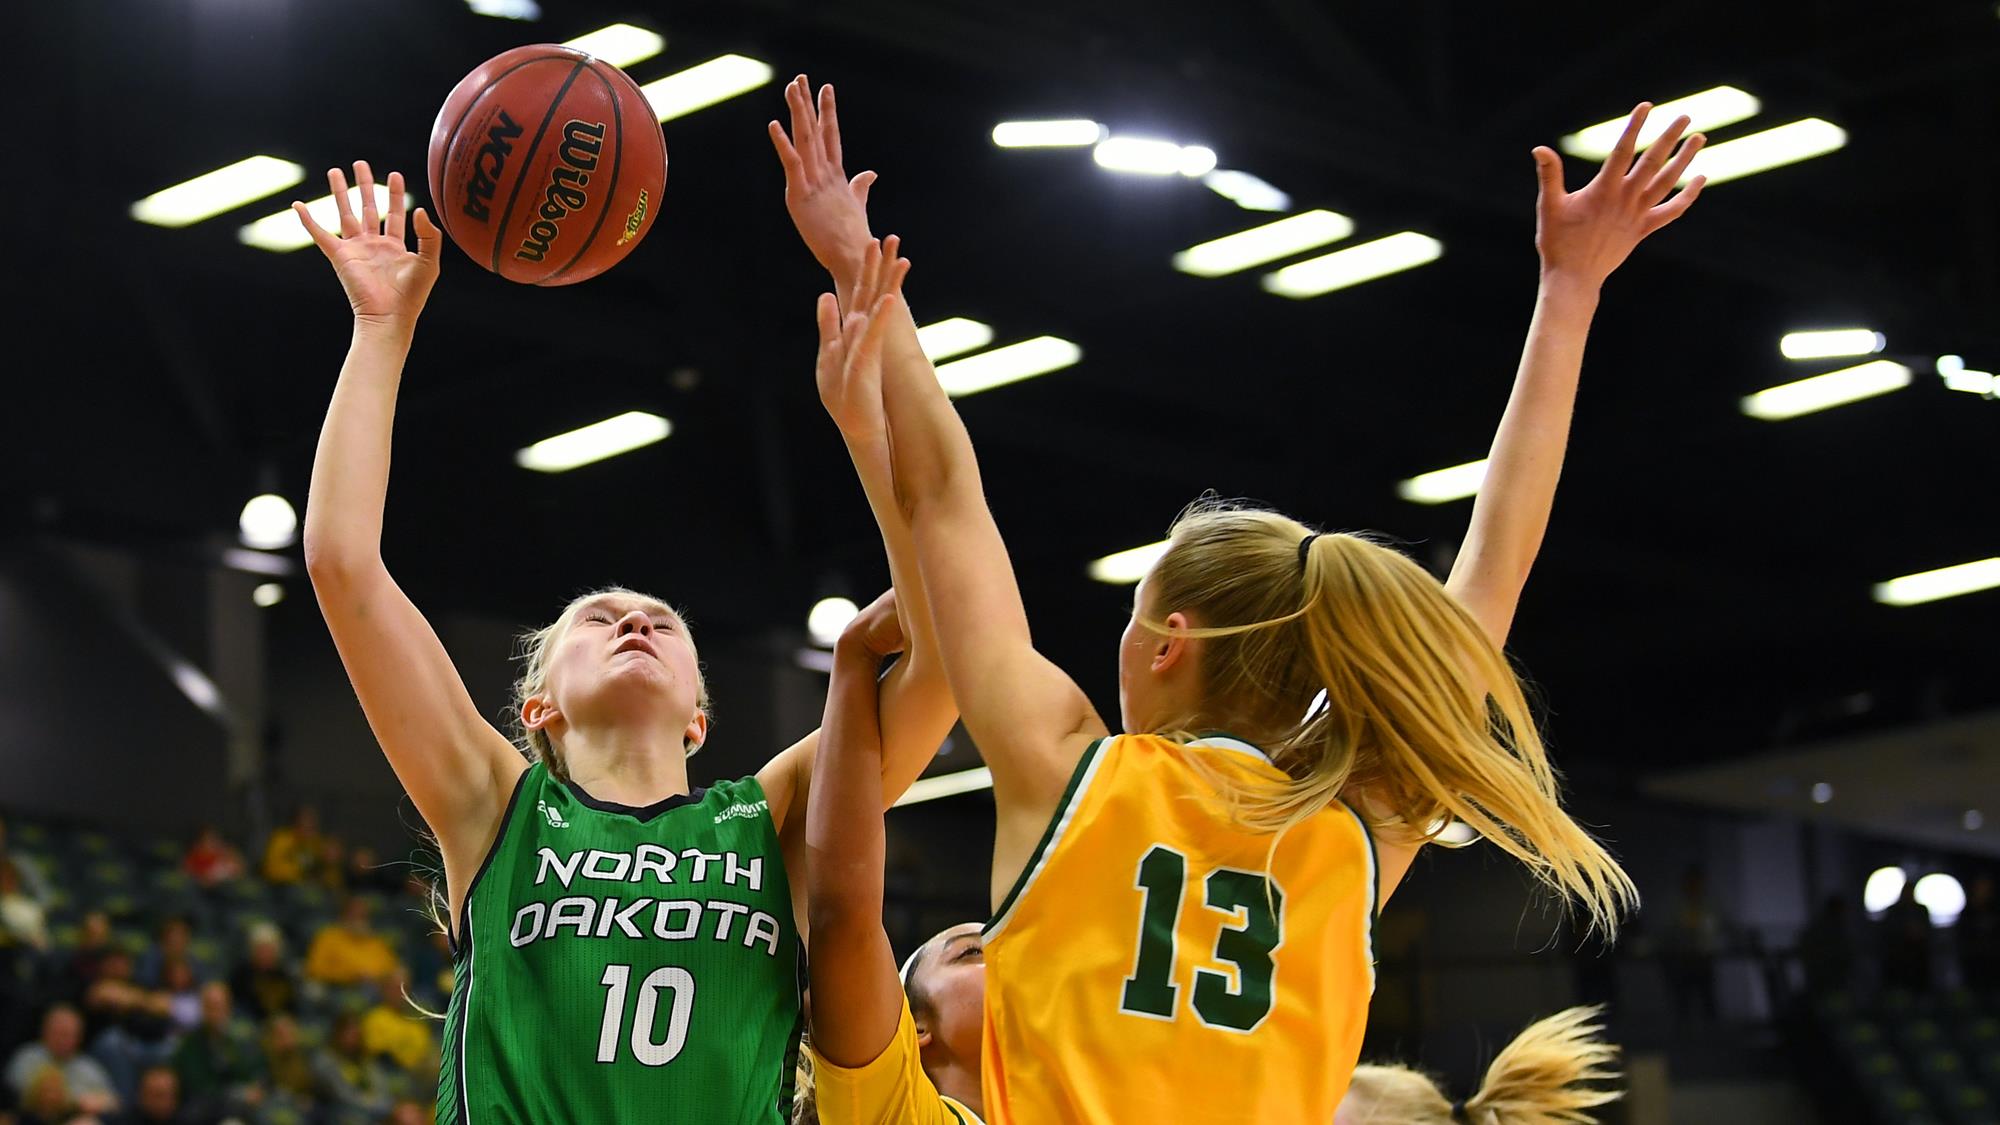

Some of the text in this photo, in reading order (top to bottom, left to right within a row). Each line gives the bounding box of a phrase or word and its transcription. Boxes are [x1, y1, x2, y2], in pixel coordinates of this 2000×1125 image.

[463, 110, 523, 223] NCAA
[515, 119, 606, 262] Wilson
[714, 800, 768, 824] SUMMIT
[534, 844, 763, 891] NORTH
[510, 897, 780, 956] DAKOTA
[1119, 843, 1286, 1035] 13
[595, 964, 696, 1067] 10
